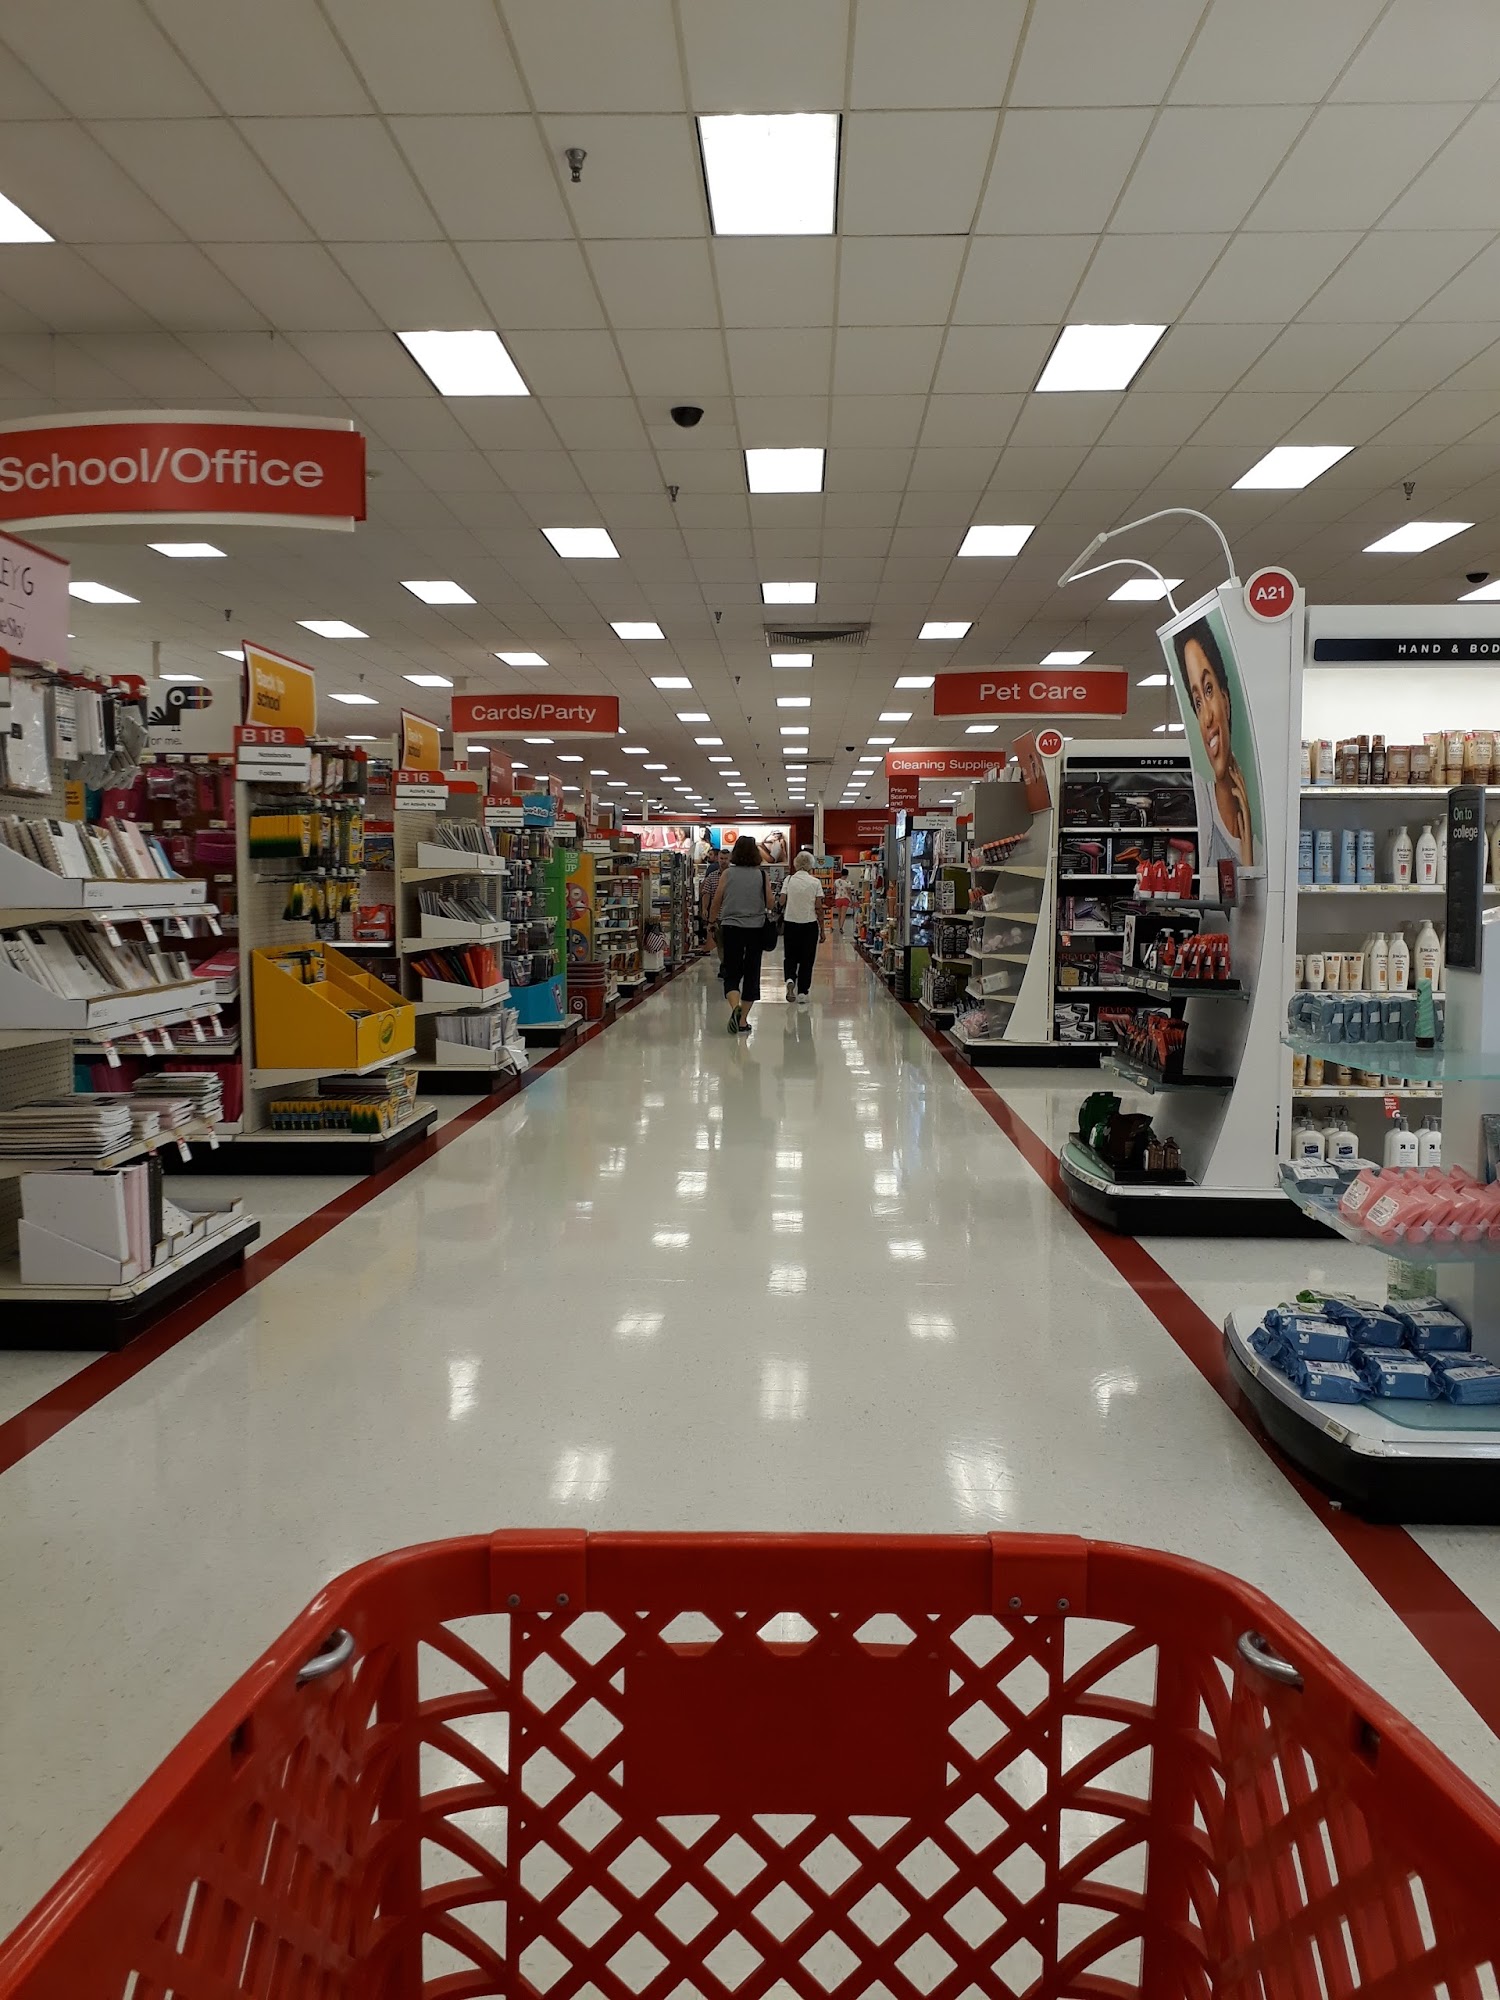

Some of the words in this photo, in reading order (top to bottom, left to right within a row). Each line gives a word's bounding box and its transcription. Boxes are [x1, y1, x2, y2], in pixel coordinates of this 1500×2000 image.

[0, 447, 324, 493] School/Office
[1255, 585, 1286, 601] A21
[1397, 643, 1442, 654] HAND
[1450, 643, 1459, 654] &
[979, 683, 1021, 701] Pet
[1028, 681, 1088, 700] Care
[256, 691, 281, 712] school
[471, 703, 598, 724] Cards/Party
[241, 728, 257, 742] B
[260, 728, 286, 743] 18
[1041, 738, 1059, 747] A17
[891, 760, 946, 772] Cleaning
[949, 759, 1000, 771] Supplies
[258, 769, 283, 777] Folders
[398, 772, 409, 783] B
[412, 772, 430, 783] 16
[486, 797, 496, 806] B
[498, 797, 511, 806] 14
[1453, 806, 1463, 821] On
[1464, 808, 1473, 821] to
[1452, 824, 1479, 842] college
[1061, 953, 1098, 961] REVLON
[1098, 1006, 1134, 1014] REVLON
